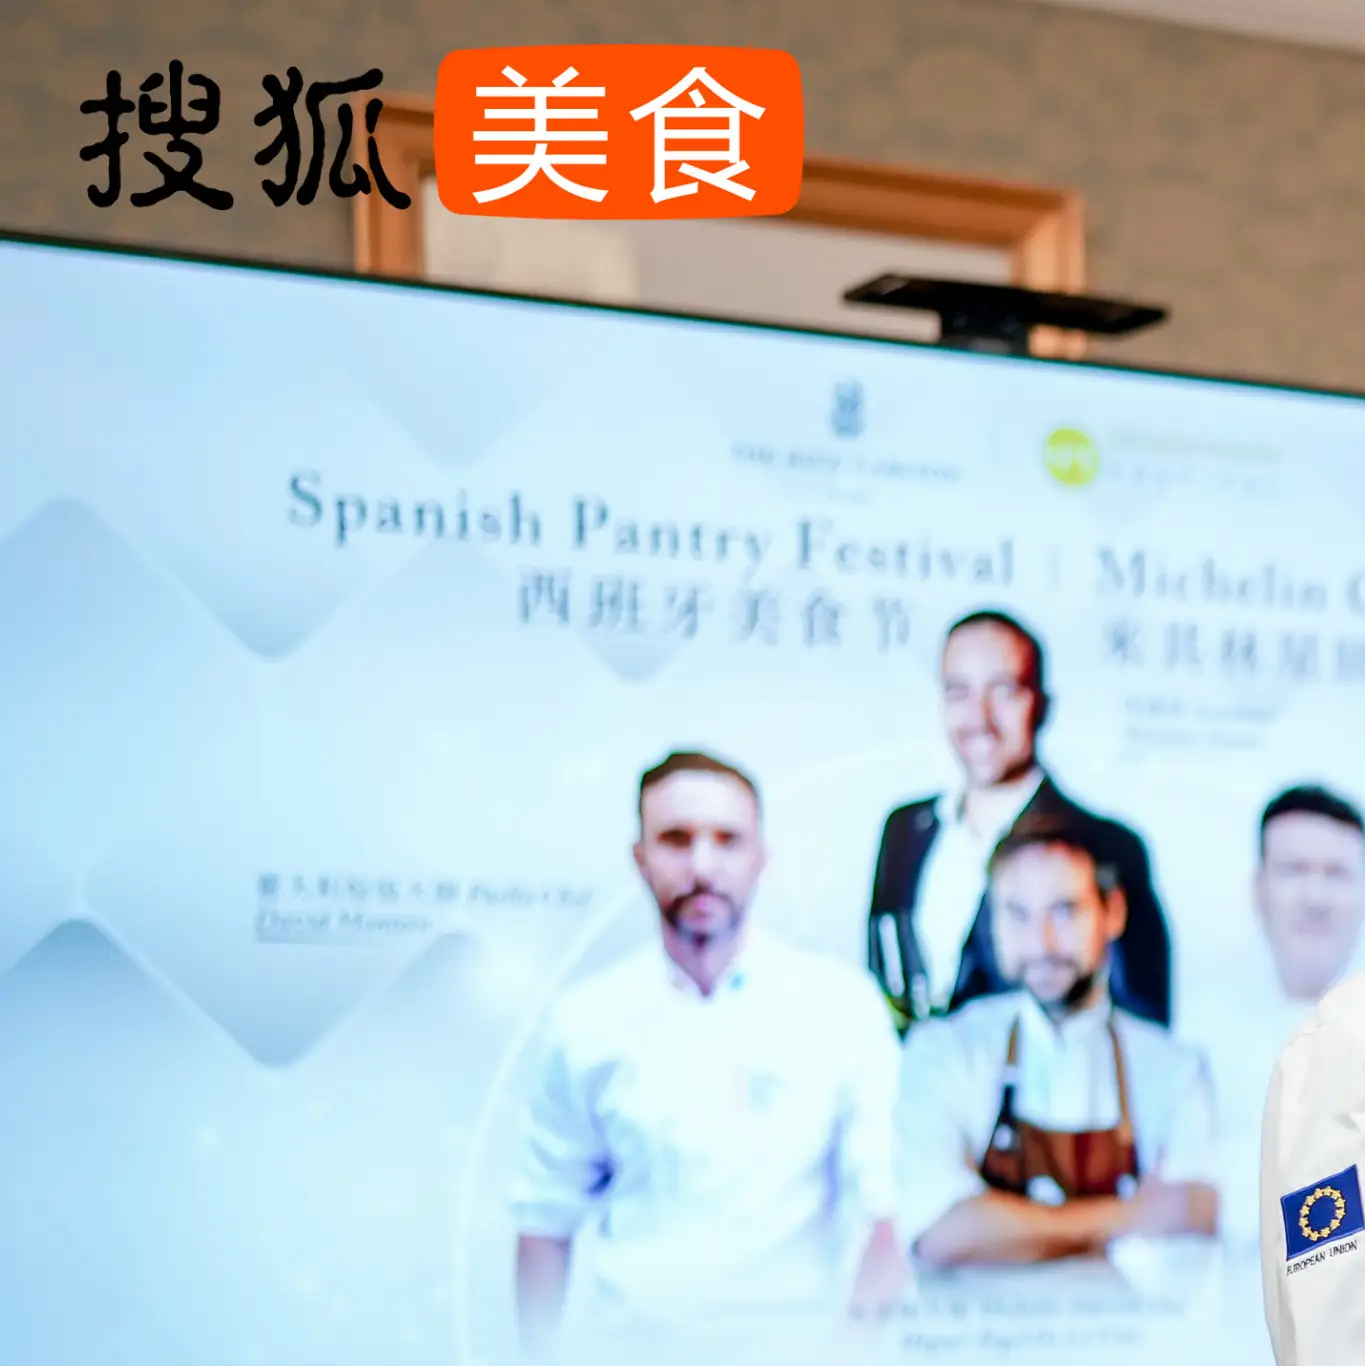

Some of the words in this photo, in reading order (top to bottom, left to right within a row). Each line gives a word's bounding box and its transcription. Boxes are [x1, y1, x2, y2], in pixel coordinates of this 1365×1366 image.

[285, 466, 545, 549] Spanish
[571, 494, 774, 578] Pantry
[797, 517, 1017, 588] Festival
[516, 565, 912, 654] 西班牙美食节
[1096, 547, 1329, 614] Michelin
[1286, 1251, 1326, 1277] EUROPEAN
[1329, 1240, 1358, 1258] UNION
